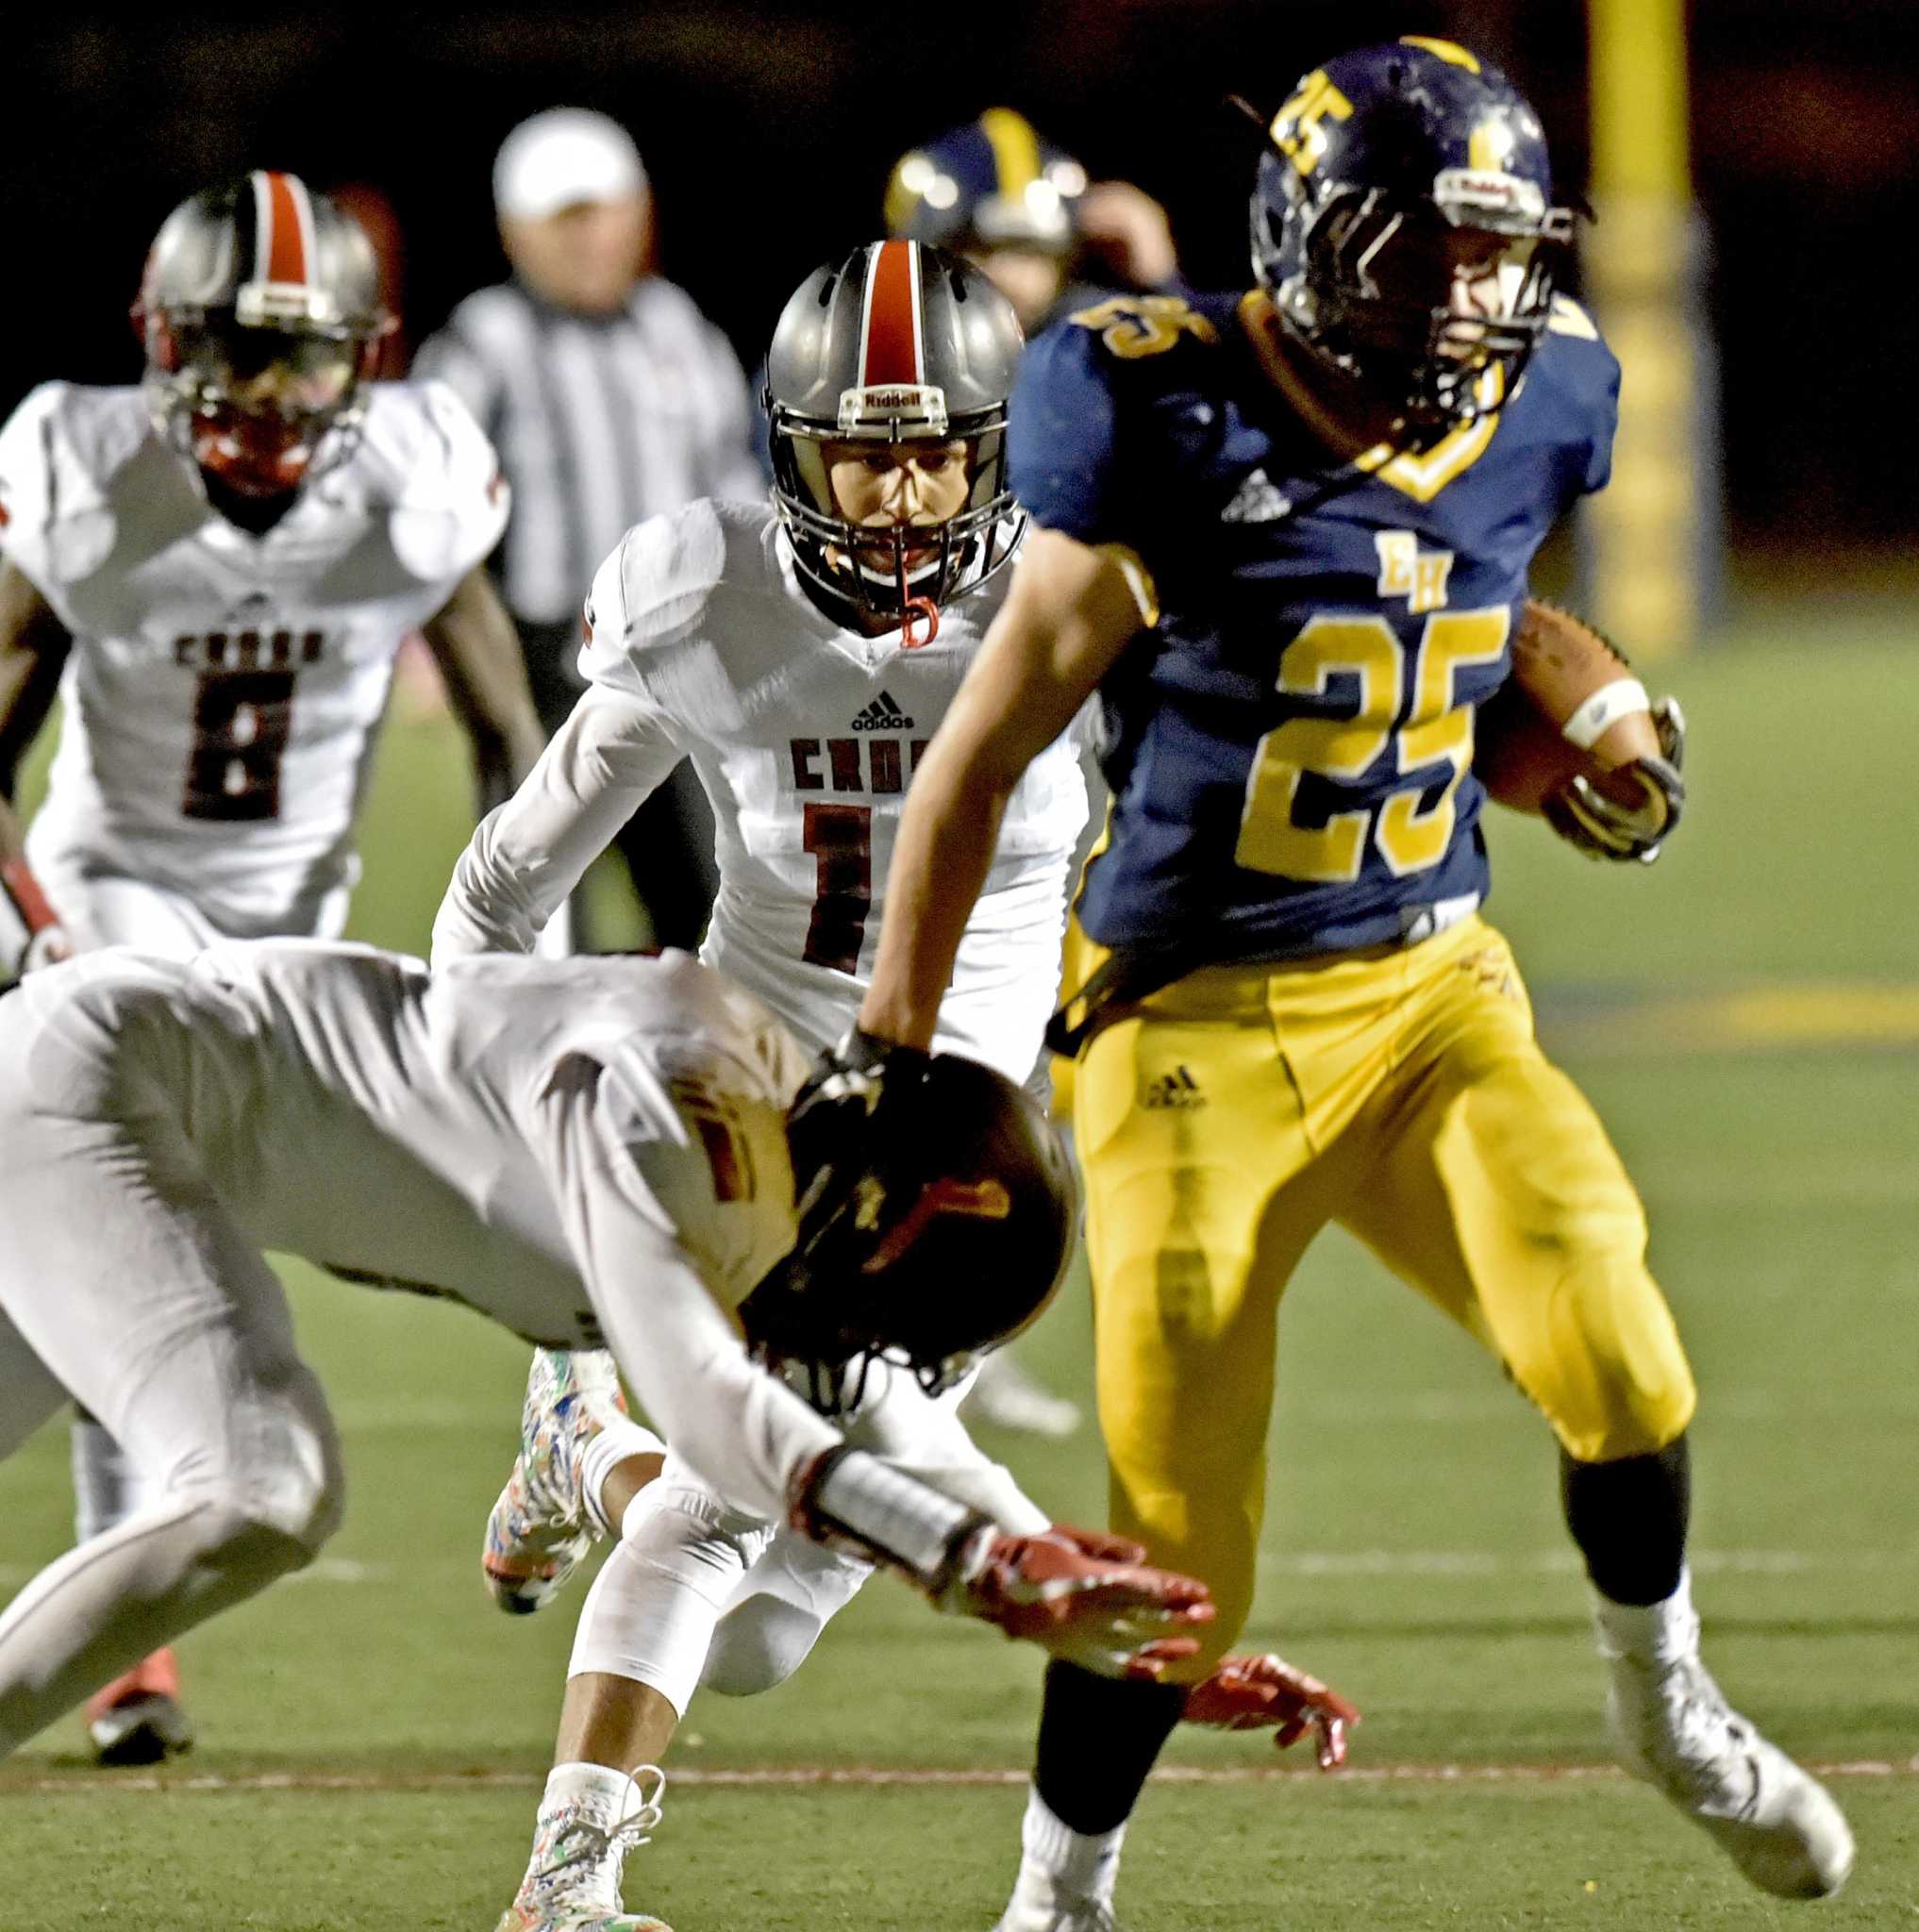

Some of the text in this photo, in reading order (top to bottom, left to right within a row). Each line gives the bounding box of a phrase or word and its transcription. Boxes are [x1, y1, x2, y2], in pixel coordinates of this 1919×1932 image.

[865, 391, 921, 408] Riddell
[851, 714, 914, 731] adidas
[1234, 604, 1510, 882] 25
